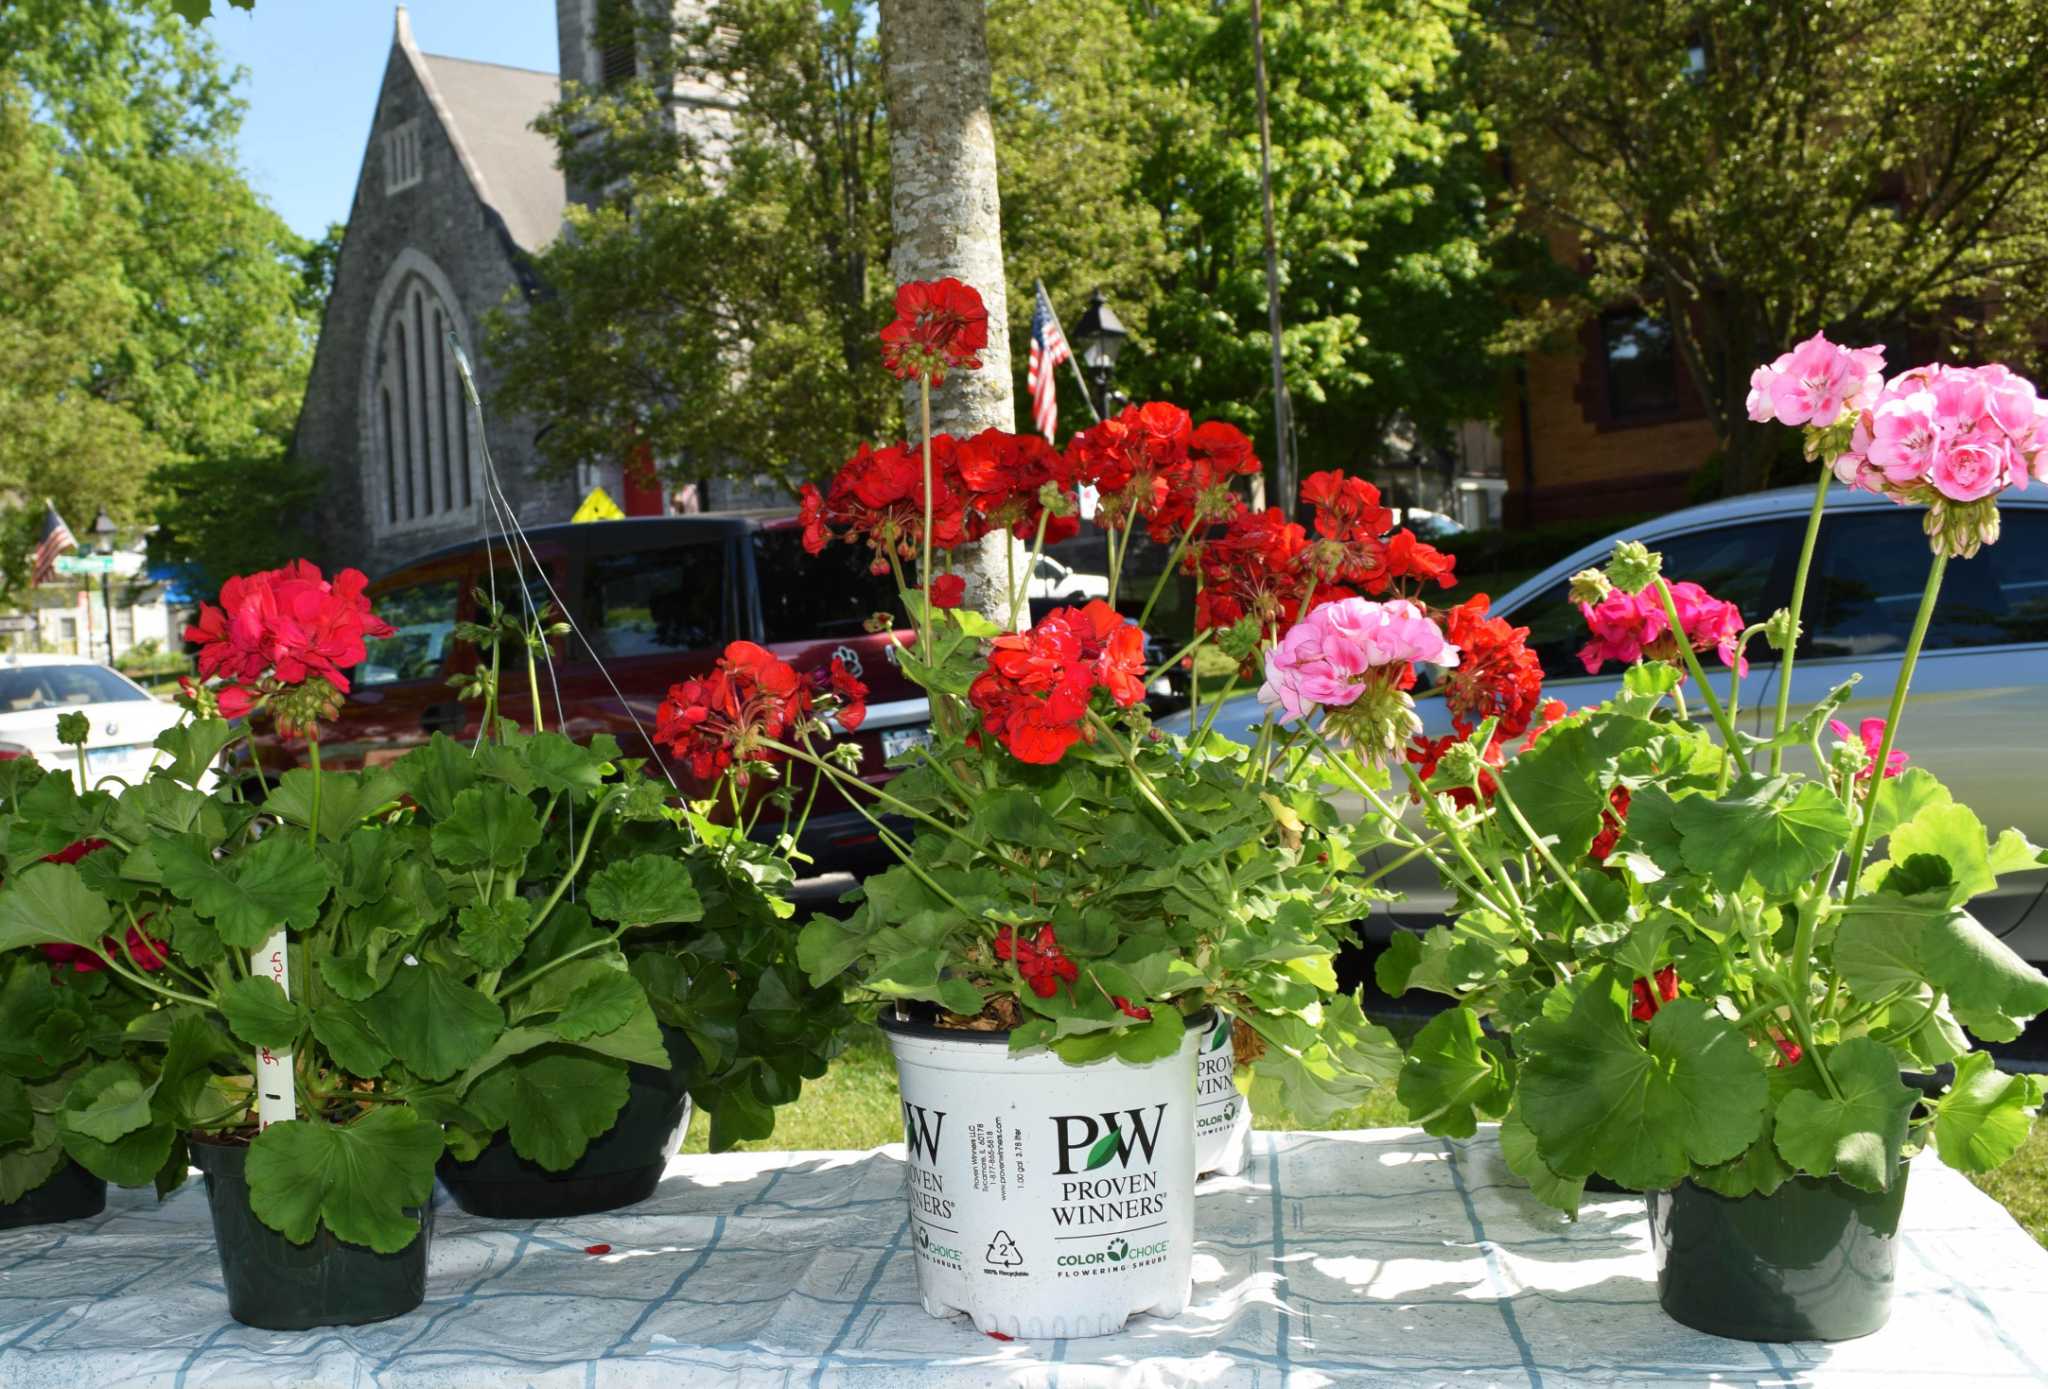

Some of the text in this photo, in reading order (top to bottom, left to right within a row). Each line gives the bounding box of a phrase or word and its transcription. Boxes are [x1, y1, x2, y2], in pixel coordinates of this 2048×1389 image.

[1198, 1056, 1233, 1076] PROV
[968, 1124, 976, 1138] LLC
[977, 1123, 986, 1146] 60178
[1016, 1160, 1025, 1173] gal
[1061, 1171, 1157, 1202] PROVEN
[929, 1242, 961, 1262] CHOICE
[1000, 1243, 1008, 1257] 2
[1057, 1240, 1169, 1267] COLOR CHOICE
[1057, 1254, 1167, 1278] FLOWERING SHRUBS
